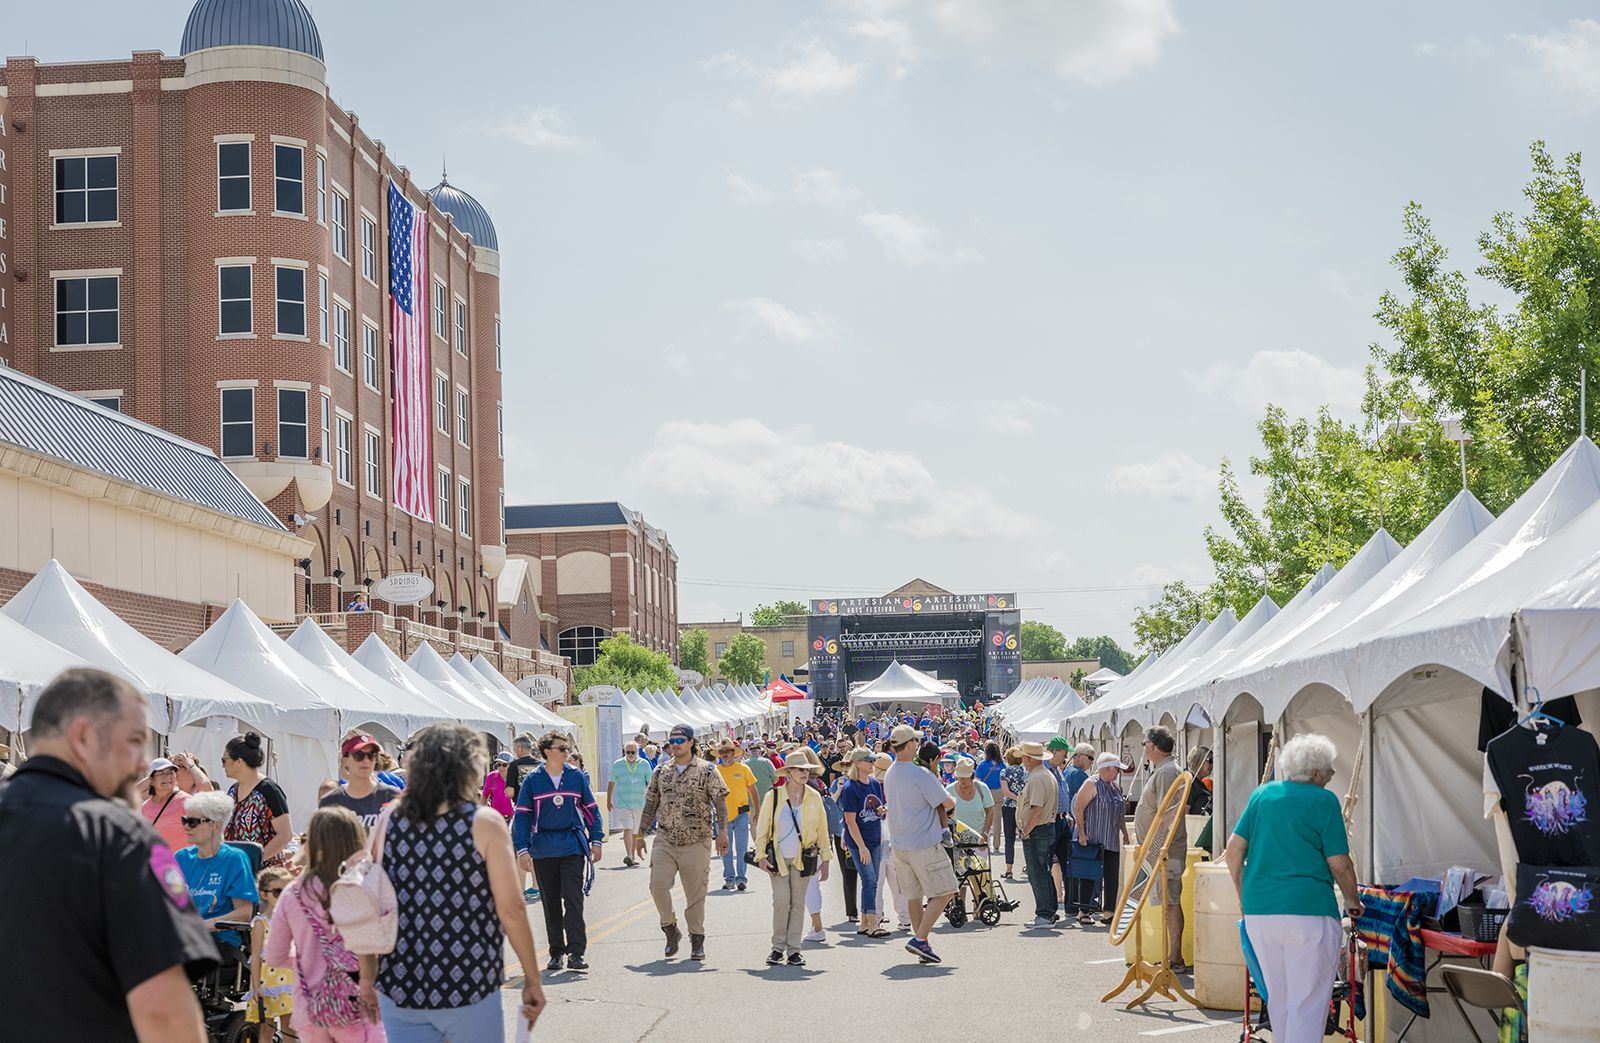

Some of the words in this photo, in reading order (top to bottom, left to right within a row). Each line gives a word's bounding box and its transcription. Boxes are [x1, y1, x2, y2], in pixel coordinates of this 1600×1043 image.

[390, 577, 419, 585] SPRINGS
[841, 597, 901, 606] ARTESIAN
[924, 595, 986, 604] ARTESIAN
[846, 606, 863, 614] ARTS
[866, 605, 897, 613] FESTIVAL
[950, 603, 981, 611] FESTIVAL
